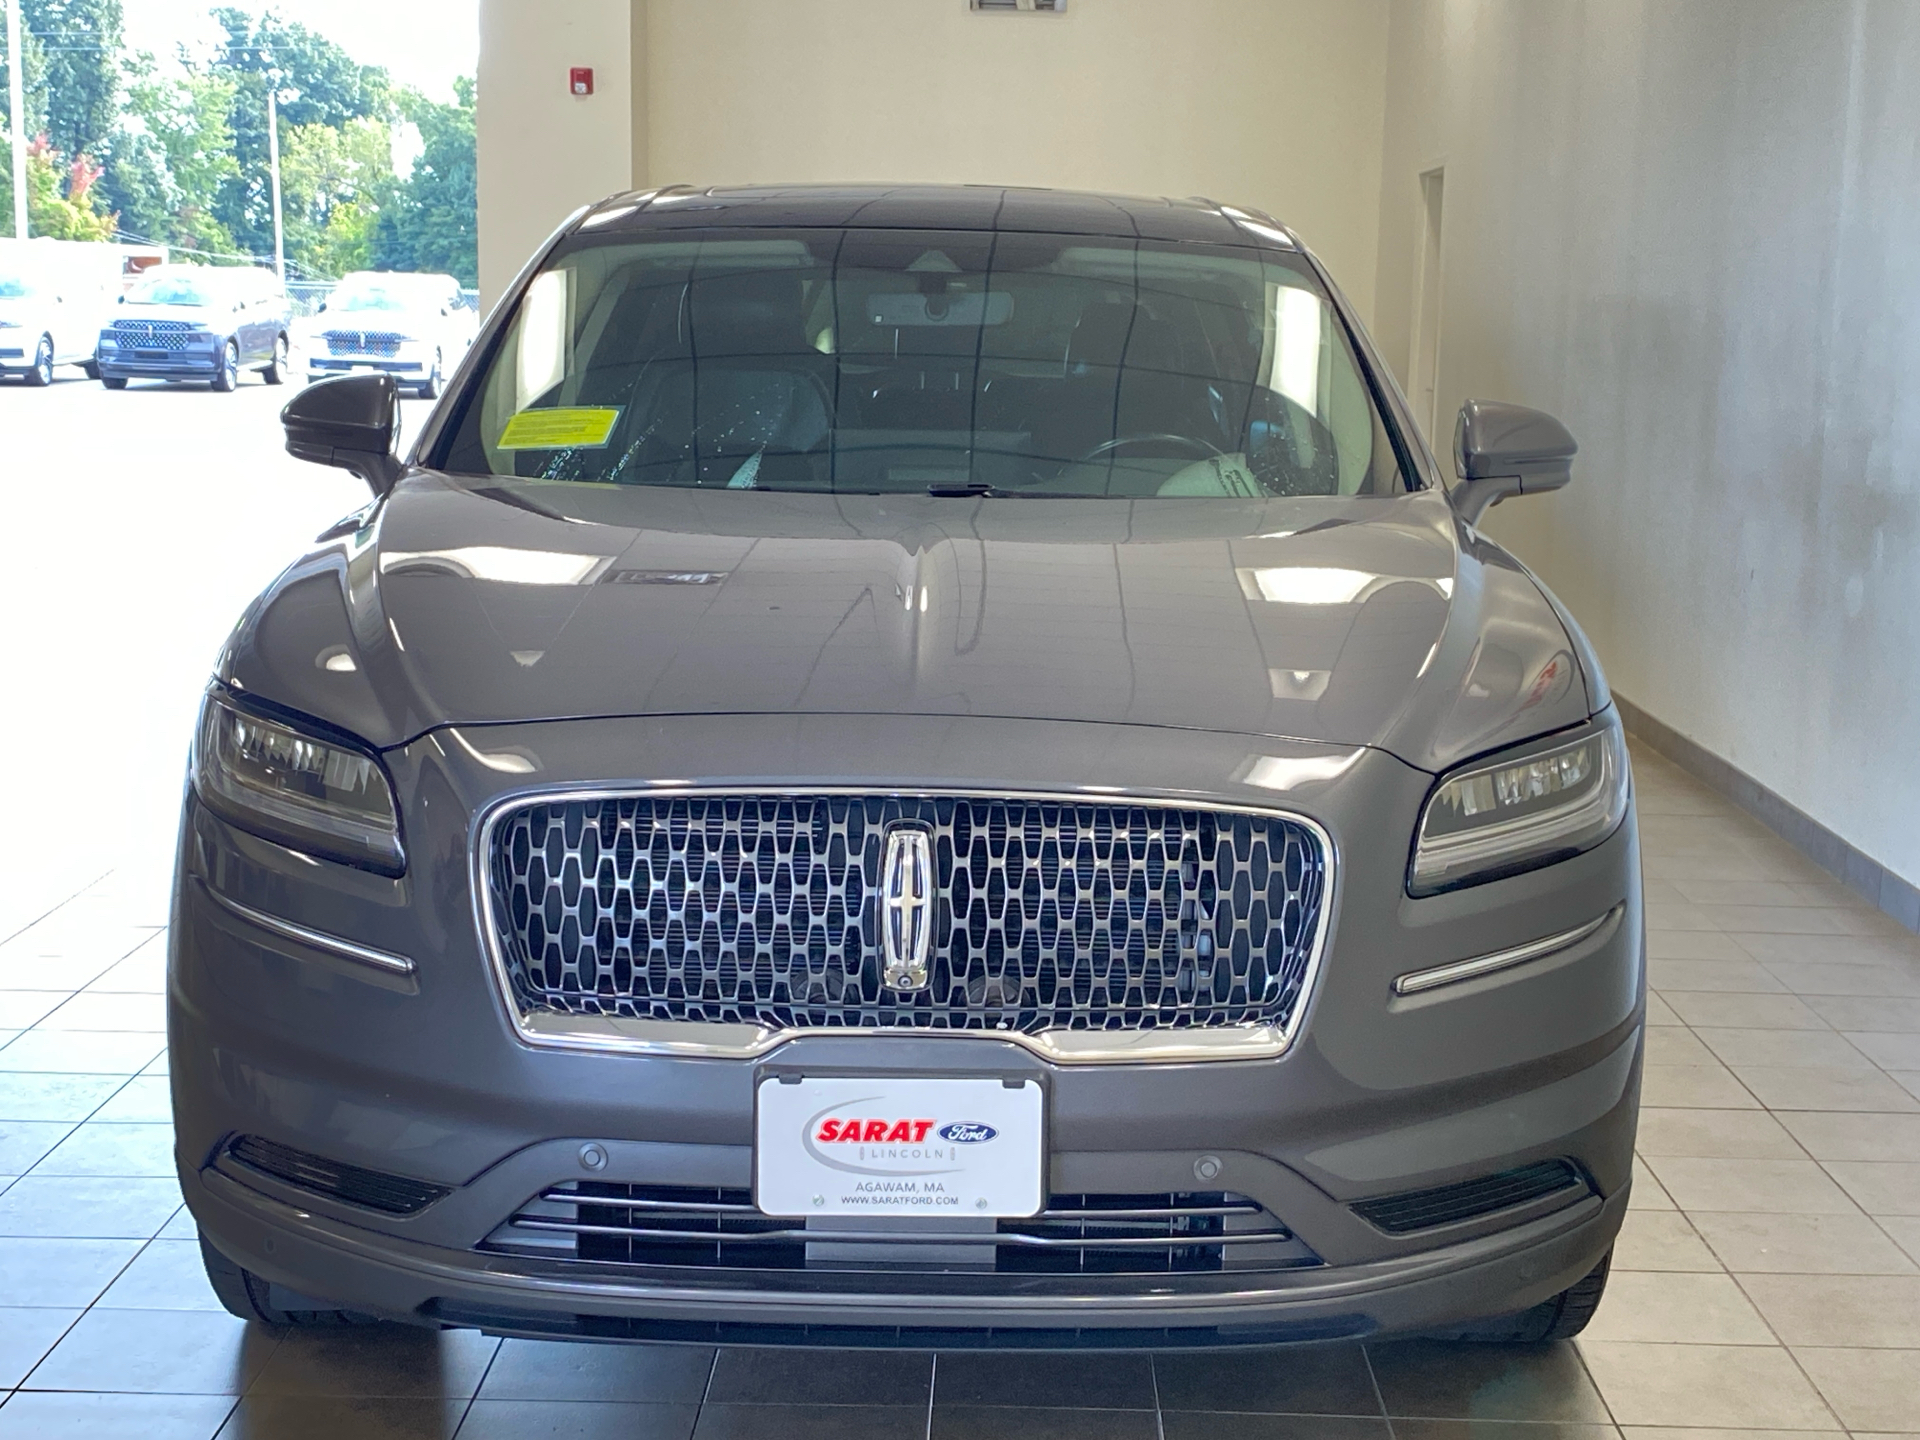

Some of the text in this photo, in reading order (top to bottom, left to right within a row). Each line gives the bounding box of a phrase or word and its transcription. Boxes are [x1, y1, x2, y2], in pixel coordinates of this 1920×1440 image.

[816, 1118, 988, 1144] SARAT Ford
[871, 1149, 943, 1159] LINCOLN
[855, 1182, 945, 1194] AGAWAM, MA
[841, 1195, 959, 1205] WWW.SARATFORD.COM
